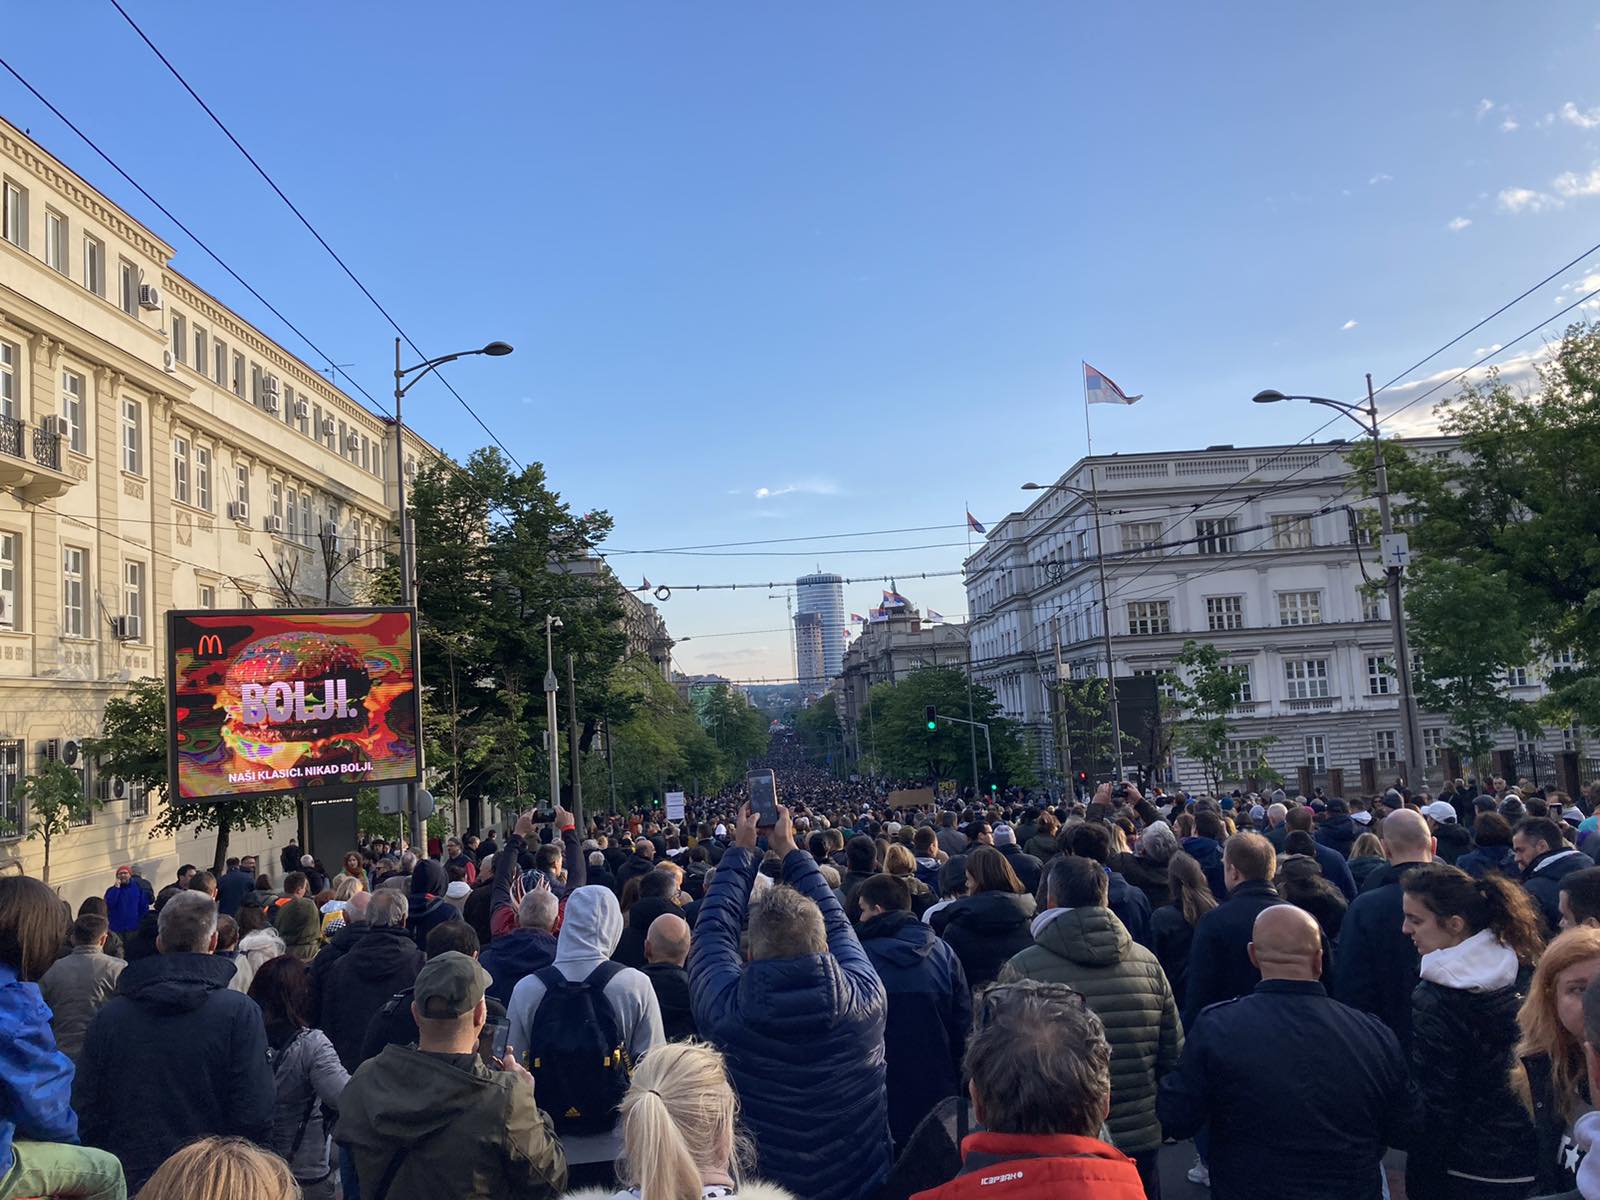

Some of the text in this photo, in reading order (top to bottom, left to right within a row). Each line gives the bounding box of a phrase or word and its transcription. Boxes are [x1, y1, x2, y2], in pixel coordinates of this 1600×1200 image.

[240, 678, 358, 725] BOLJI.
[228, 761, 374, 783] NAŠI KLASICI. NIKAD BOLJI.
